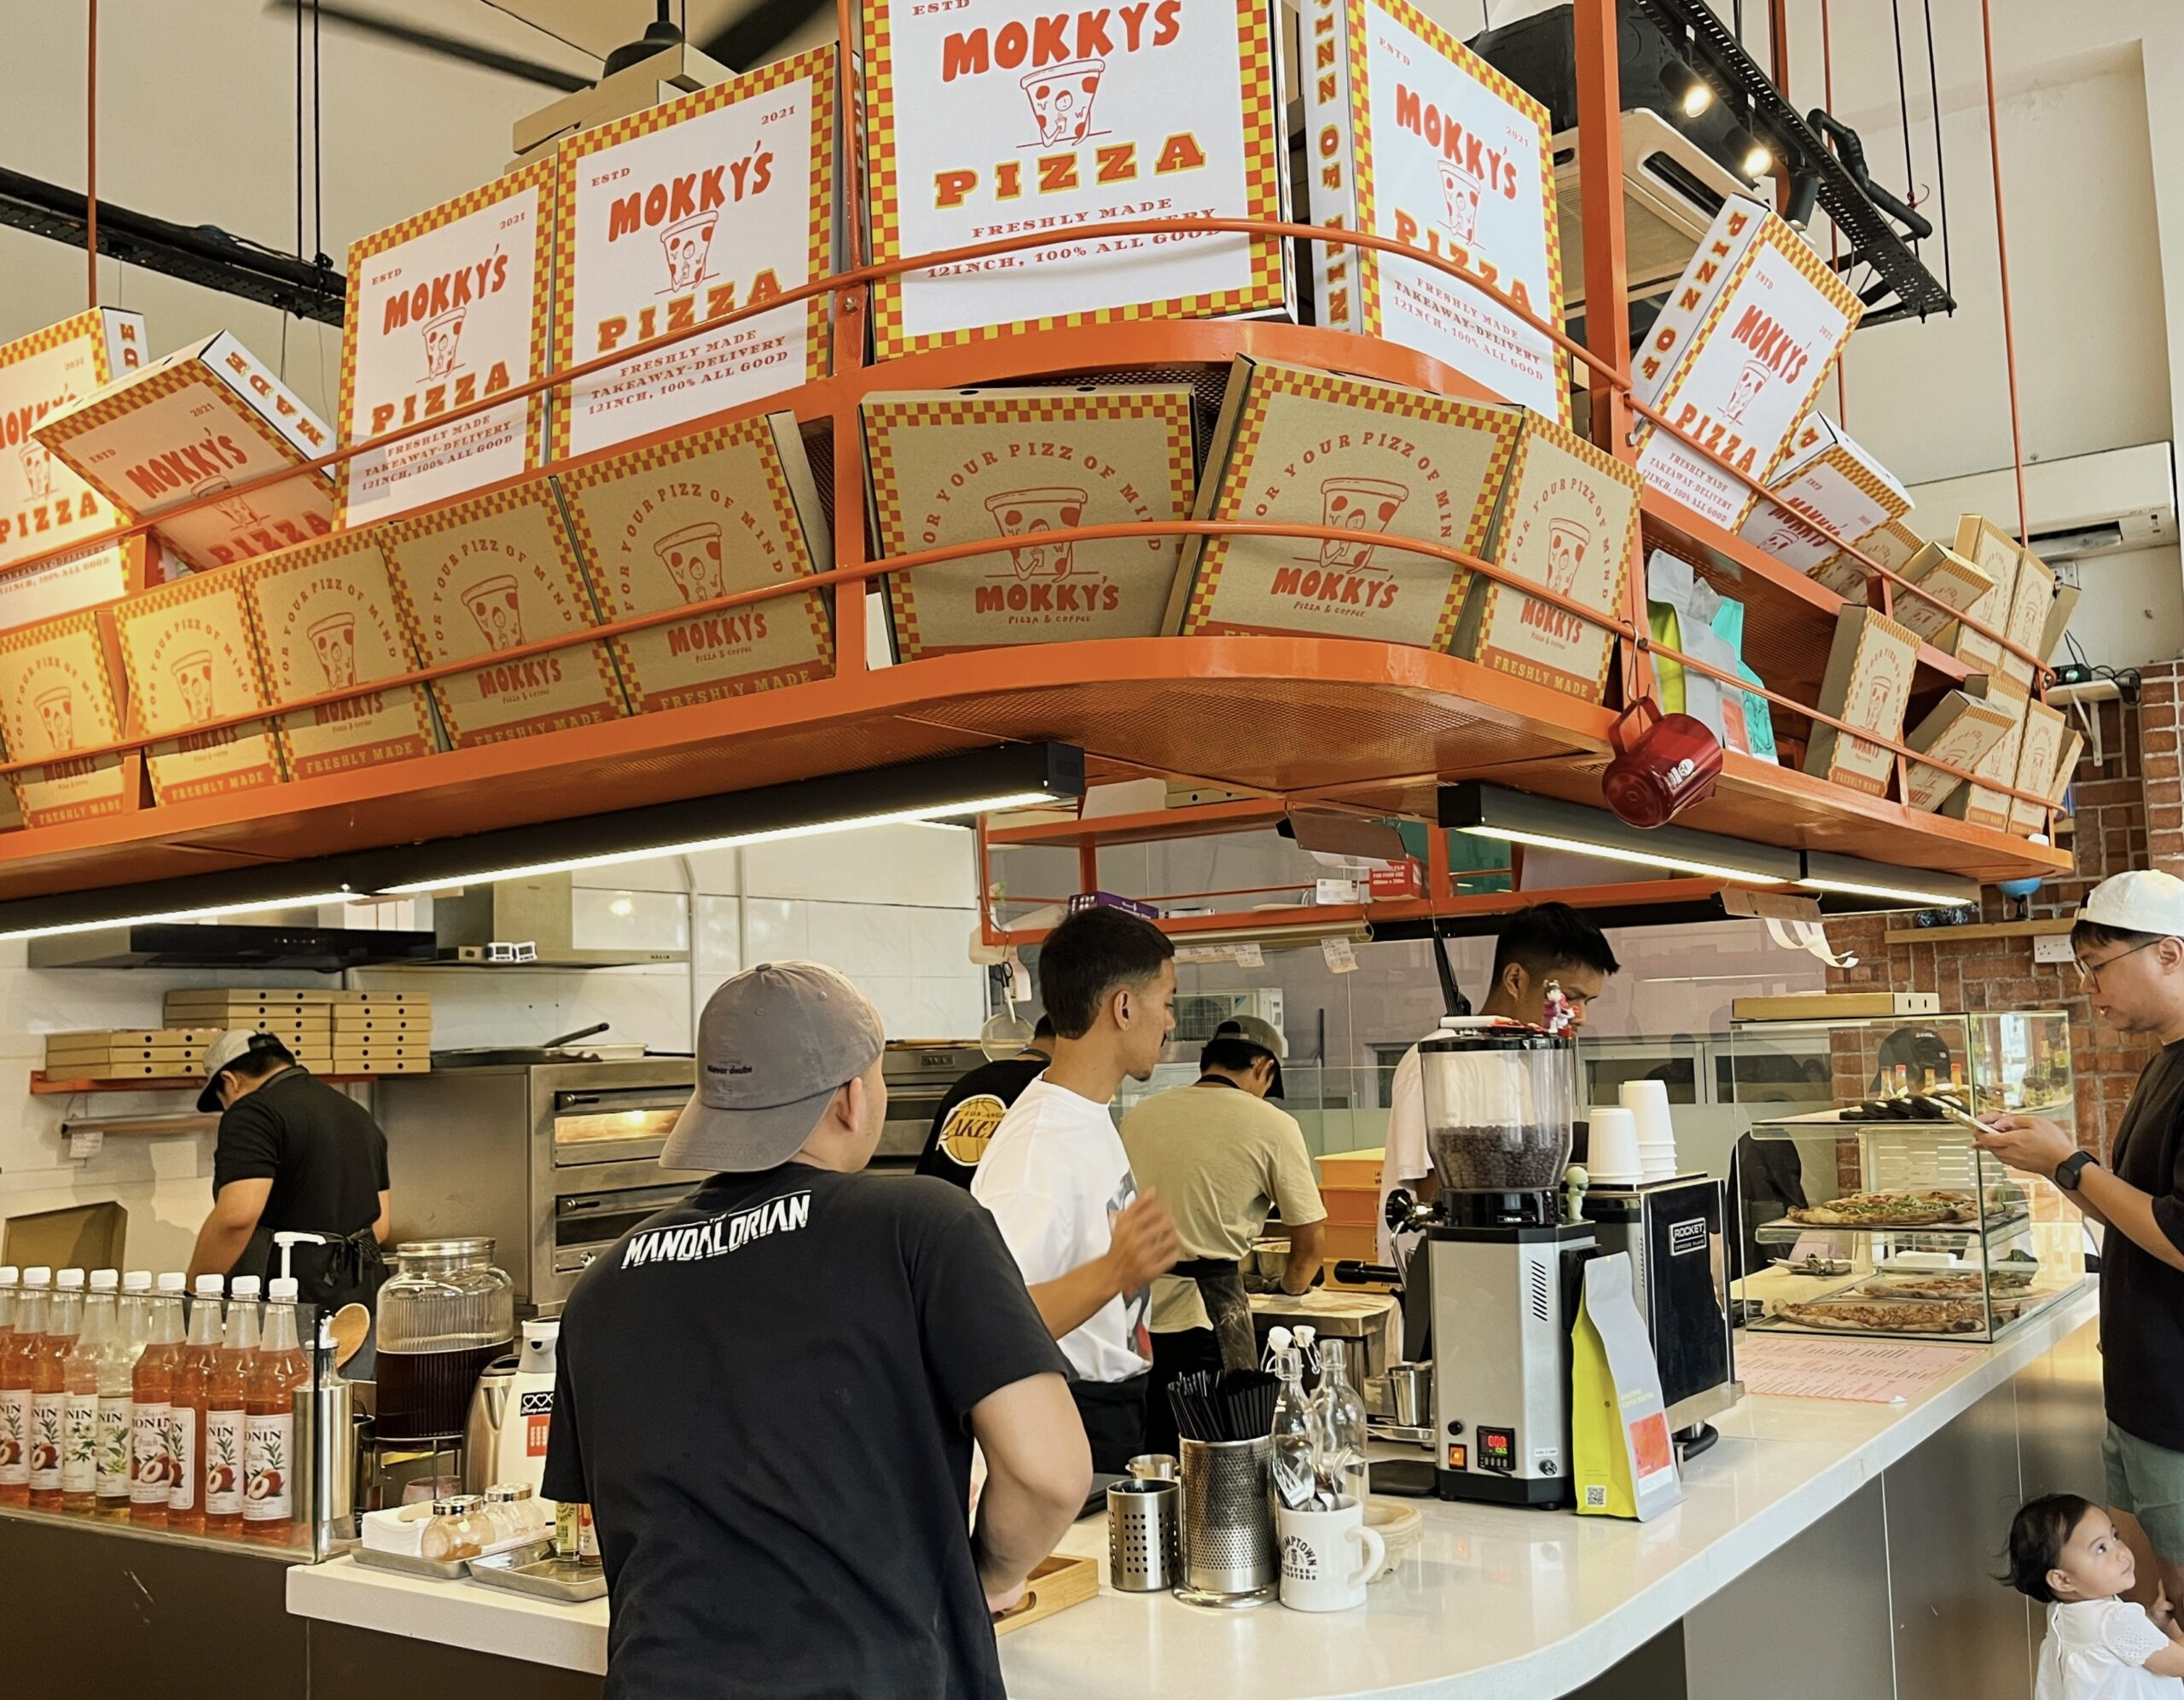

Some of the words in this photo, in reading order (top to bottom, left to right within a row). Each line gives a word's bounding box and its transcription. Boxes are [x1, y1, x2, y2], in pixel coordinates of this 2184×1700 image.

[1314, 0, 1337, 106] IZZ
[1378, 36, 1411, 67] ESTD
[761, 105, 796, 125] 2021
[1396, 83, 1517, 200] MOKKY'S
[1505, 125, 1530, 148] 2021
[591, 168, 631, 187] ESTD
[933, 131, 1206, 211] PIZZA
[1318, 123, 1341, 191] OF
[608, 140, 774, 242] MOKKY'S
[972, 212, 1089, 238] FRESHLY
[1099, 198, 1172, 219] MADE
[499, 212, 526, 229] 2021
[372, 268, 402, 285] ESTD
[926, 258, 1025, 278] 12INCH,
[1035, 247, 1087, 263] 100%
[1095, 237, 1144, 254] ALL
[1323, 212, 1350, 333] MIN
[1394, 207, 1534, 315] PIZZA
[1677, 208, 1748, 313] PIZZ
[383, 244, 508, 335] MOKKY'S
[597, 268, 782, 353] PIZZA
[1416, 277, 1478, 316] FRESHLY
[1484, 314, 1519, 339] MADE
[1395, 281, 1541, 365] TAKEAWAY-DELIVERY
[1731, 305, 1812, 384] MOKKY'S
[591, 336, 786, 399] TAKEAWAY-DELIVERY
[619, 347, 700, 377] FRESHLY
[706, 330, 757, 354] MADE
[660, 378, 695, 396] 100%
[701, 367, 735, 383] ALL
[741, 351, 788, 372] GOOD
[1452, 328, 1480, 351] 100%
[1483, 345, 1508, 365] ALL
[1510, 358, 1544, 381] GOOD
[1641, 325, 1676, 382] OF
[226, 351, 326, 448] MADE
[370, 361, 511, 436] PIZZA
[365, 421, 512, 476] TAKEAWAY-DELIVERY
[387, 431, 448, 456] FRESHLY
[453, 415, 491, 438] MADE
[447, 450, 473, 465] ALL
[477, 435, 513, 453] GOOD
[1676, 403, 1761, 473] PIZZA
[125, 427, 247, 499] MOKKY'S
[1255, 485, 1280, 516] OR
[1284, 434, 1350, 478] YOUR
[1362, 431, 1415, 458] PIZZ
[1417, 456, 1440, 481] OF
[1435, 489, 1452, 539] MIN
[657, 483, 702, 502] PIZZ
[710, 490, 735, 509] OF
[922, 513, 941, 547] OR
[936, 451, 998, 503] YOUR
[1008, 442, 1074, 461] PIZZ
[1083, 455, 1116, 479] OF
[461, 538, 499, 557] PIZZ
[621, 499, 654, 554] YOUR
[741, 511, 783, 573] MIND
[1511, 520, 1531, 564] FOR
[1532, 478, 1565, 514] YOUR
[1571, 478, 1596, 504] PIZZ
[1594, 505, 1606, 528] OF
[433, 554, 459, 604] YOUR
[505, 543, 527, 563] OF
[532, 565, 572, 623] MIND
[620, 566, 635, 612] FOR
[975, 576, 1119, 614] MOKKY'S
[1270, 566, 1400, 610] MOKKY'S
[284, 590, 309, 636] YOUR
[311, 577, 343, 593] PIZZ
[347, 583, 365, 601] OF
[368, 604, 397, 659] MIND
[433, 613, 448, 657] FOR
[659, 682, 746, 711] FRESHLY
[753, 669, 811, 693] MADE
[1493, 654, 1550, 686] FRESHLY
[1554, 675, 1589, 697] MADE
[555, 711, 602, 731] MADE
[306, 751, 368, 775] FRESHLY
[372, 741, 413, 762] MADE
[171, 780, 224, 800] FRESHLY
[229, 771, 265, 790] MADE
[621, 1194, 810, 1269] MANDALORIAN
[1674, 1223, 1705, 1239] ROCKET
